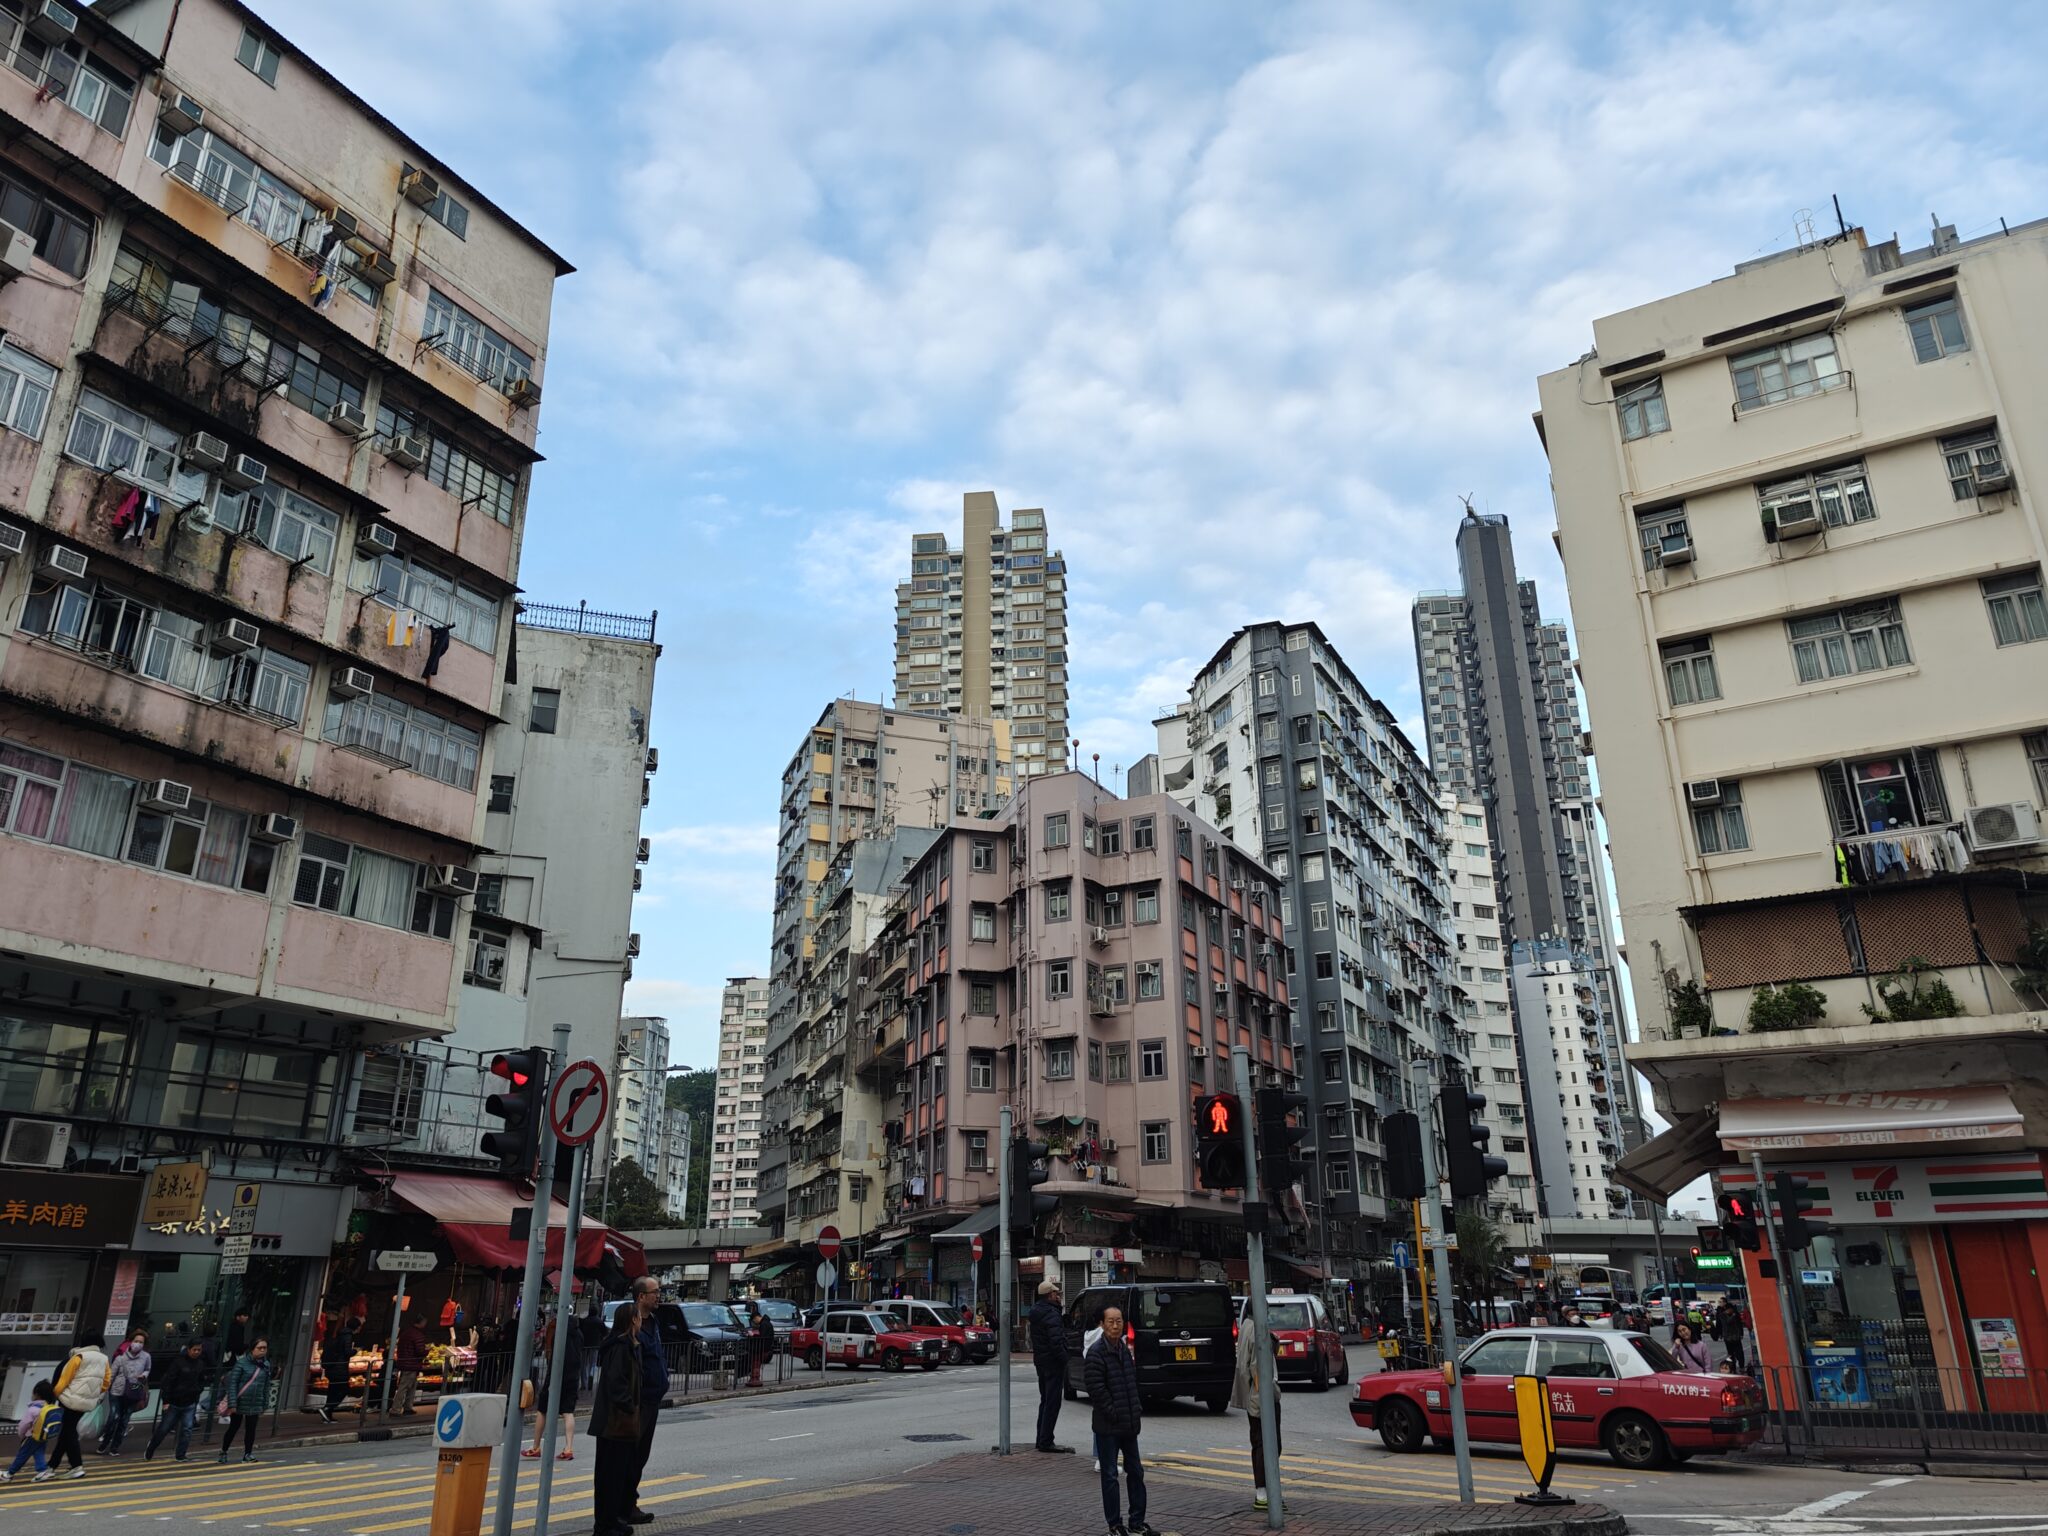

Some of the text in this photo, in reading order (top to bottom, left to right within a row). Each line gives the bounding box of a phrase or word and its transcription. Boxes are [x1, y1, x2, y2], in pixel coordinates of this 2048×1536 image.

[0, 1200, 88, 1228] 羊肉館
[1815, 1356, 1845, 1366] OREO
[1551, 1392, 1574, 1403] 的士
[1553, 1402, 1575, 1413] TAXI
